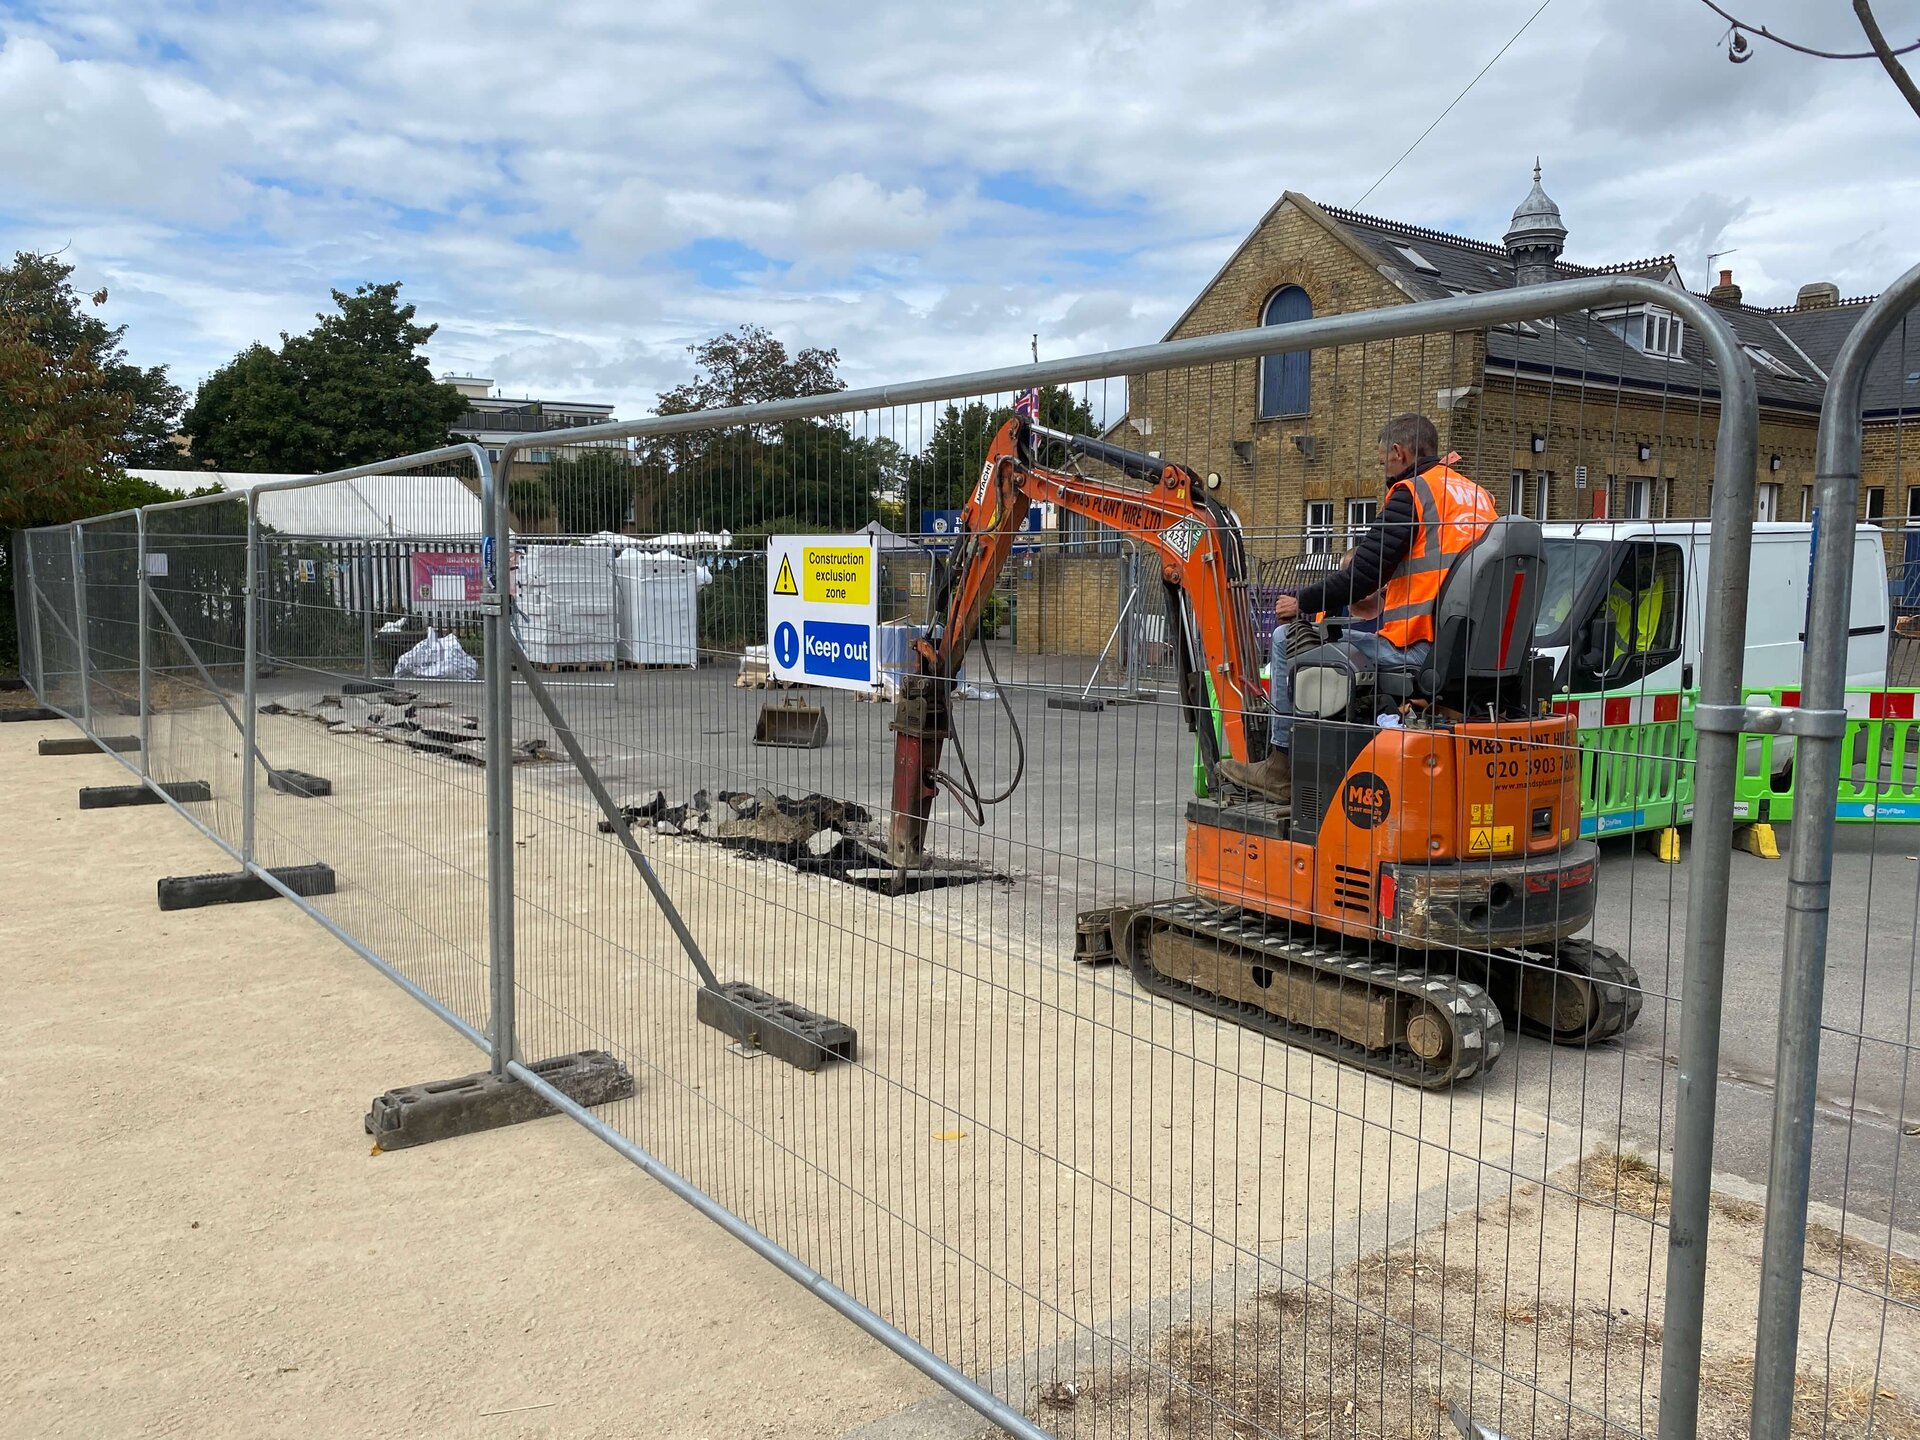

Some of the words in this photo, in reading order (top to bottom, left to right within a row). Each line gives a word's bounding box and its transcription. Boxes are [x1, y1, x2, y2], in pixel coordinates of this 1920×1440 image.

[976, 464, 993, 502] HITACHI
[1072, 492, 1090, 508] M&S
[1092, 497, 1121, 519] PLANT
[1122, 502, 1142, 526] HIRE
[1143, 509, 1161, 533] LTD
[809, 552, 864, 565] Construction
[815, 569, 857, 582] exclusion
[825, 588, 847, 599] zone
[805, 634, 840, 663] Keep
[844, 641, 868, 661] out
[1468, 738, 1503, 755] M&S
[1509, 733, 1550, 753] PLANT
[1486, 760, 1519, 778] 020
[1525, 757, 1556, 776] 3903
[1349, 785, 1384, 807] M&S
